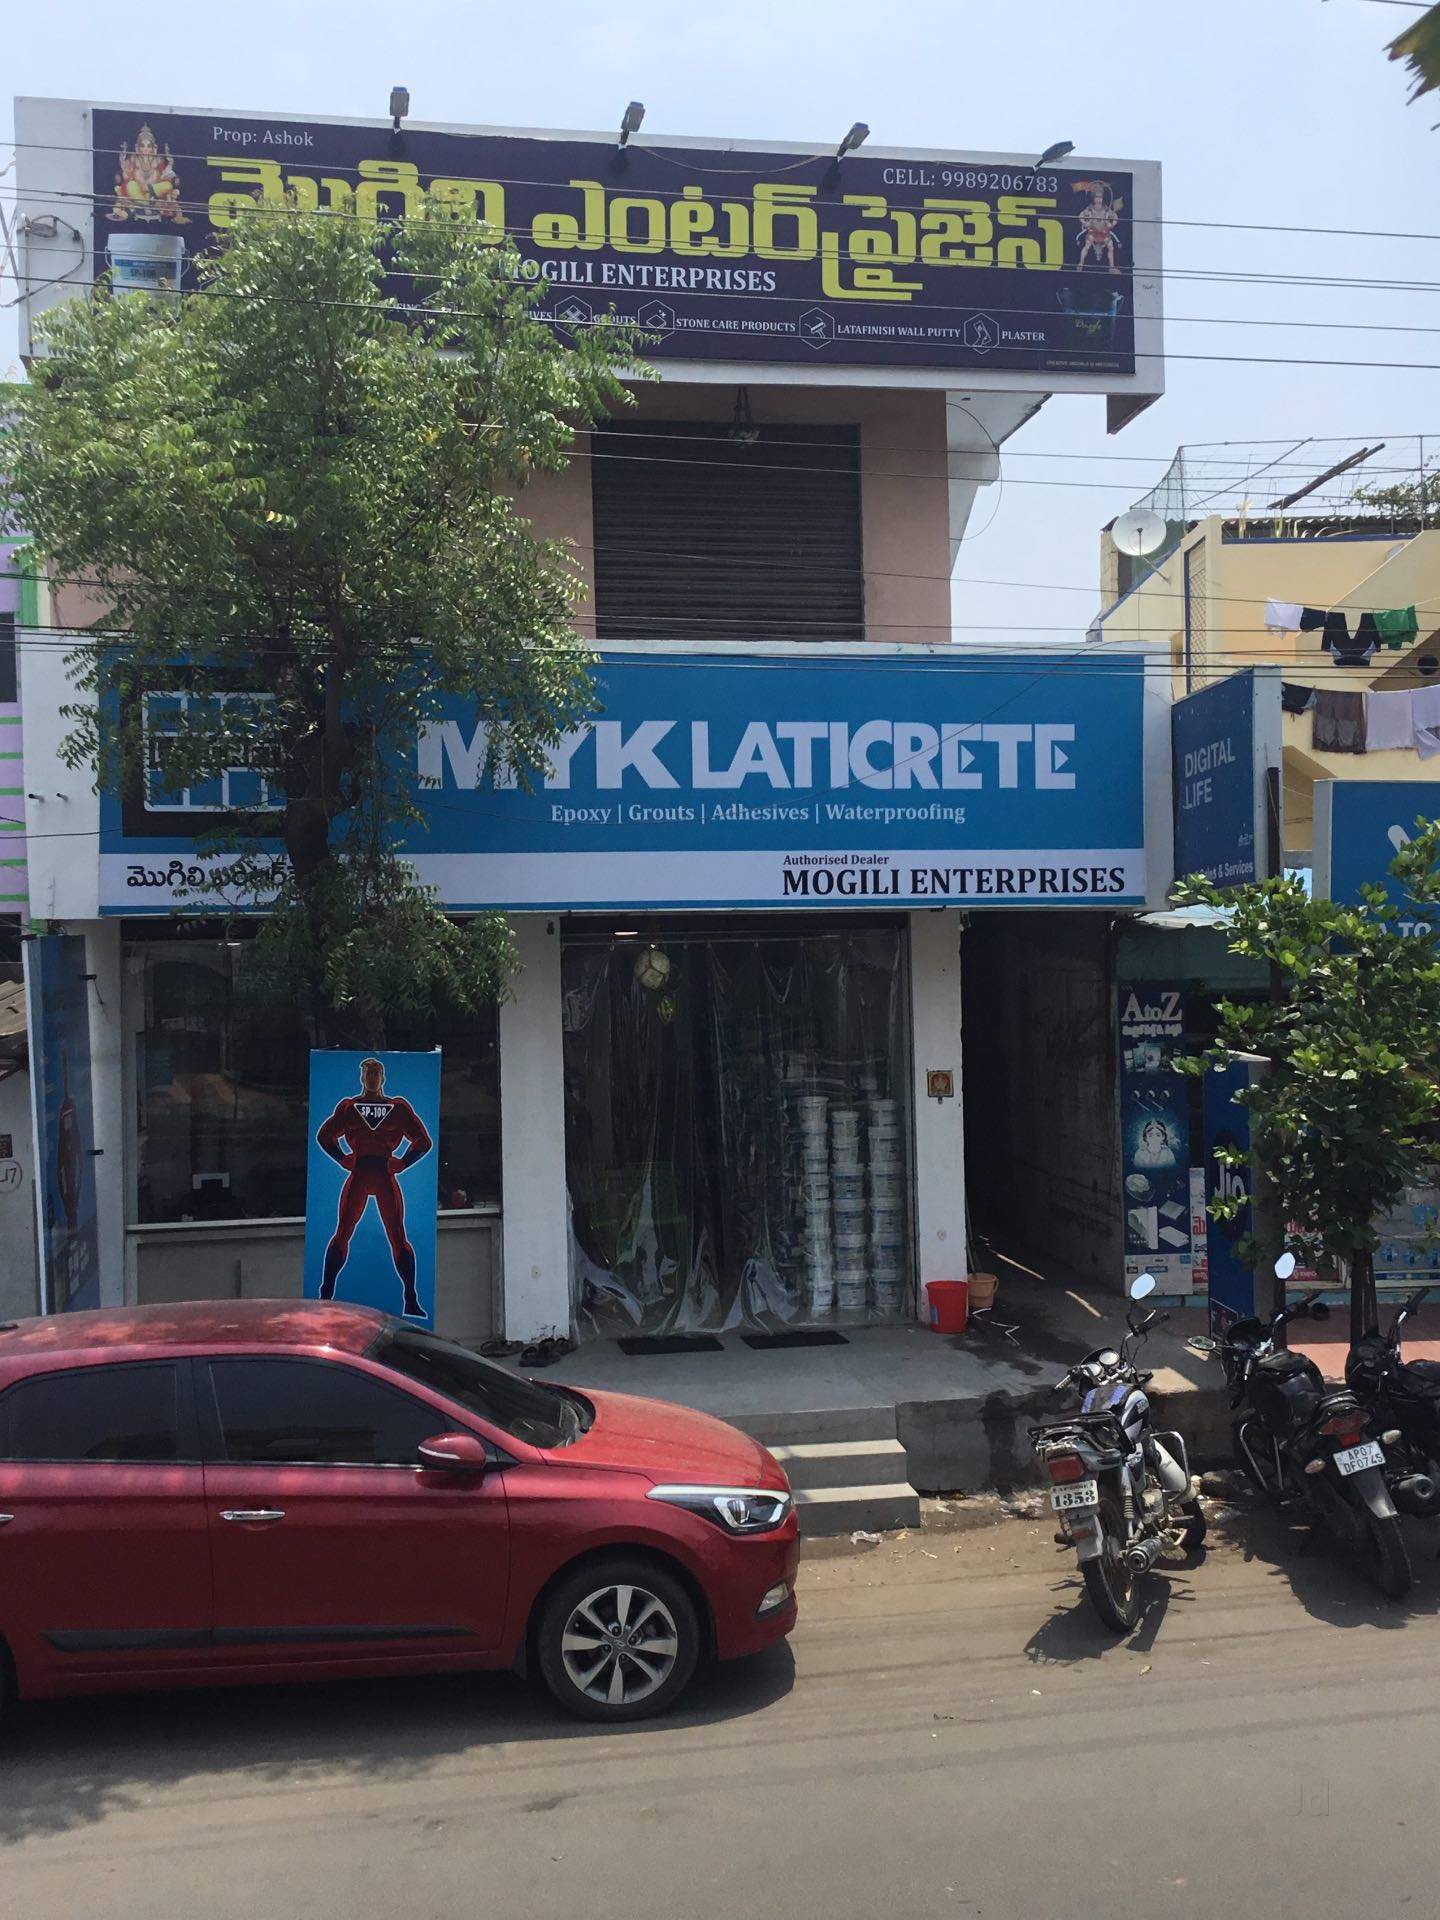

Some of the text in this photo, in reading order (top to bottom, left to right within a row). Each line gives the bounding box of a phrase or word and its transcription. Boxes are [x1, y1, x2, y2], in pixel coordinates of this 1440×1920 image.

[213, 126, 313, 146] Prop: Ashok
[883, 168, 1057, 192] CELL: 9989206783
[602, 263, 776, 292] ENTERPRISES
[676, 318, 796, 332] STONE CARE PRODUCTS
[837, 324, 961, 338] LATAFINISH WALL PUTTY
[1001, 331, 1046, 342] PLASTER
[416, 719, 1077, 790] MYK LATICRETE
[1184, 738, 1236, 778] DIGITAL
[1182, 777, 1213, 810] LIFE
[551, 802, 966, 826] Epoxy Grouts Adhesives Waterproofing
[783, 854, 890, 866] Authorised Dealer
[1224, 861, 1254, 877] Services
[127, 860, 205, 887] మొగిలి
[782, 867, 1125, 896] MOGILI ENTERPRISES
[1348, 1445, 1373, 1461] AP07
